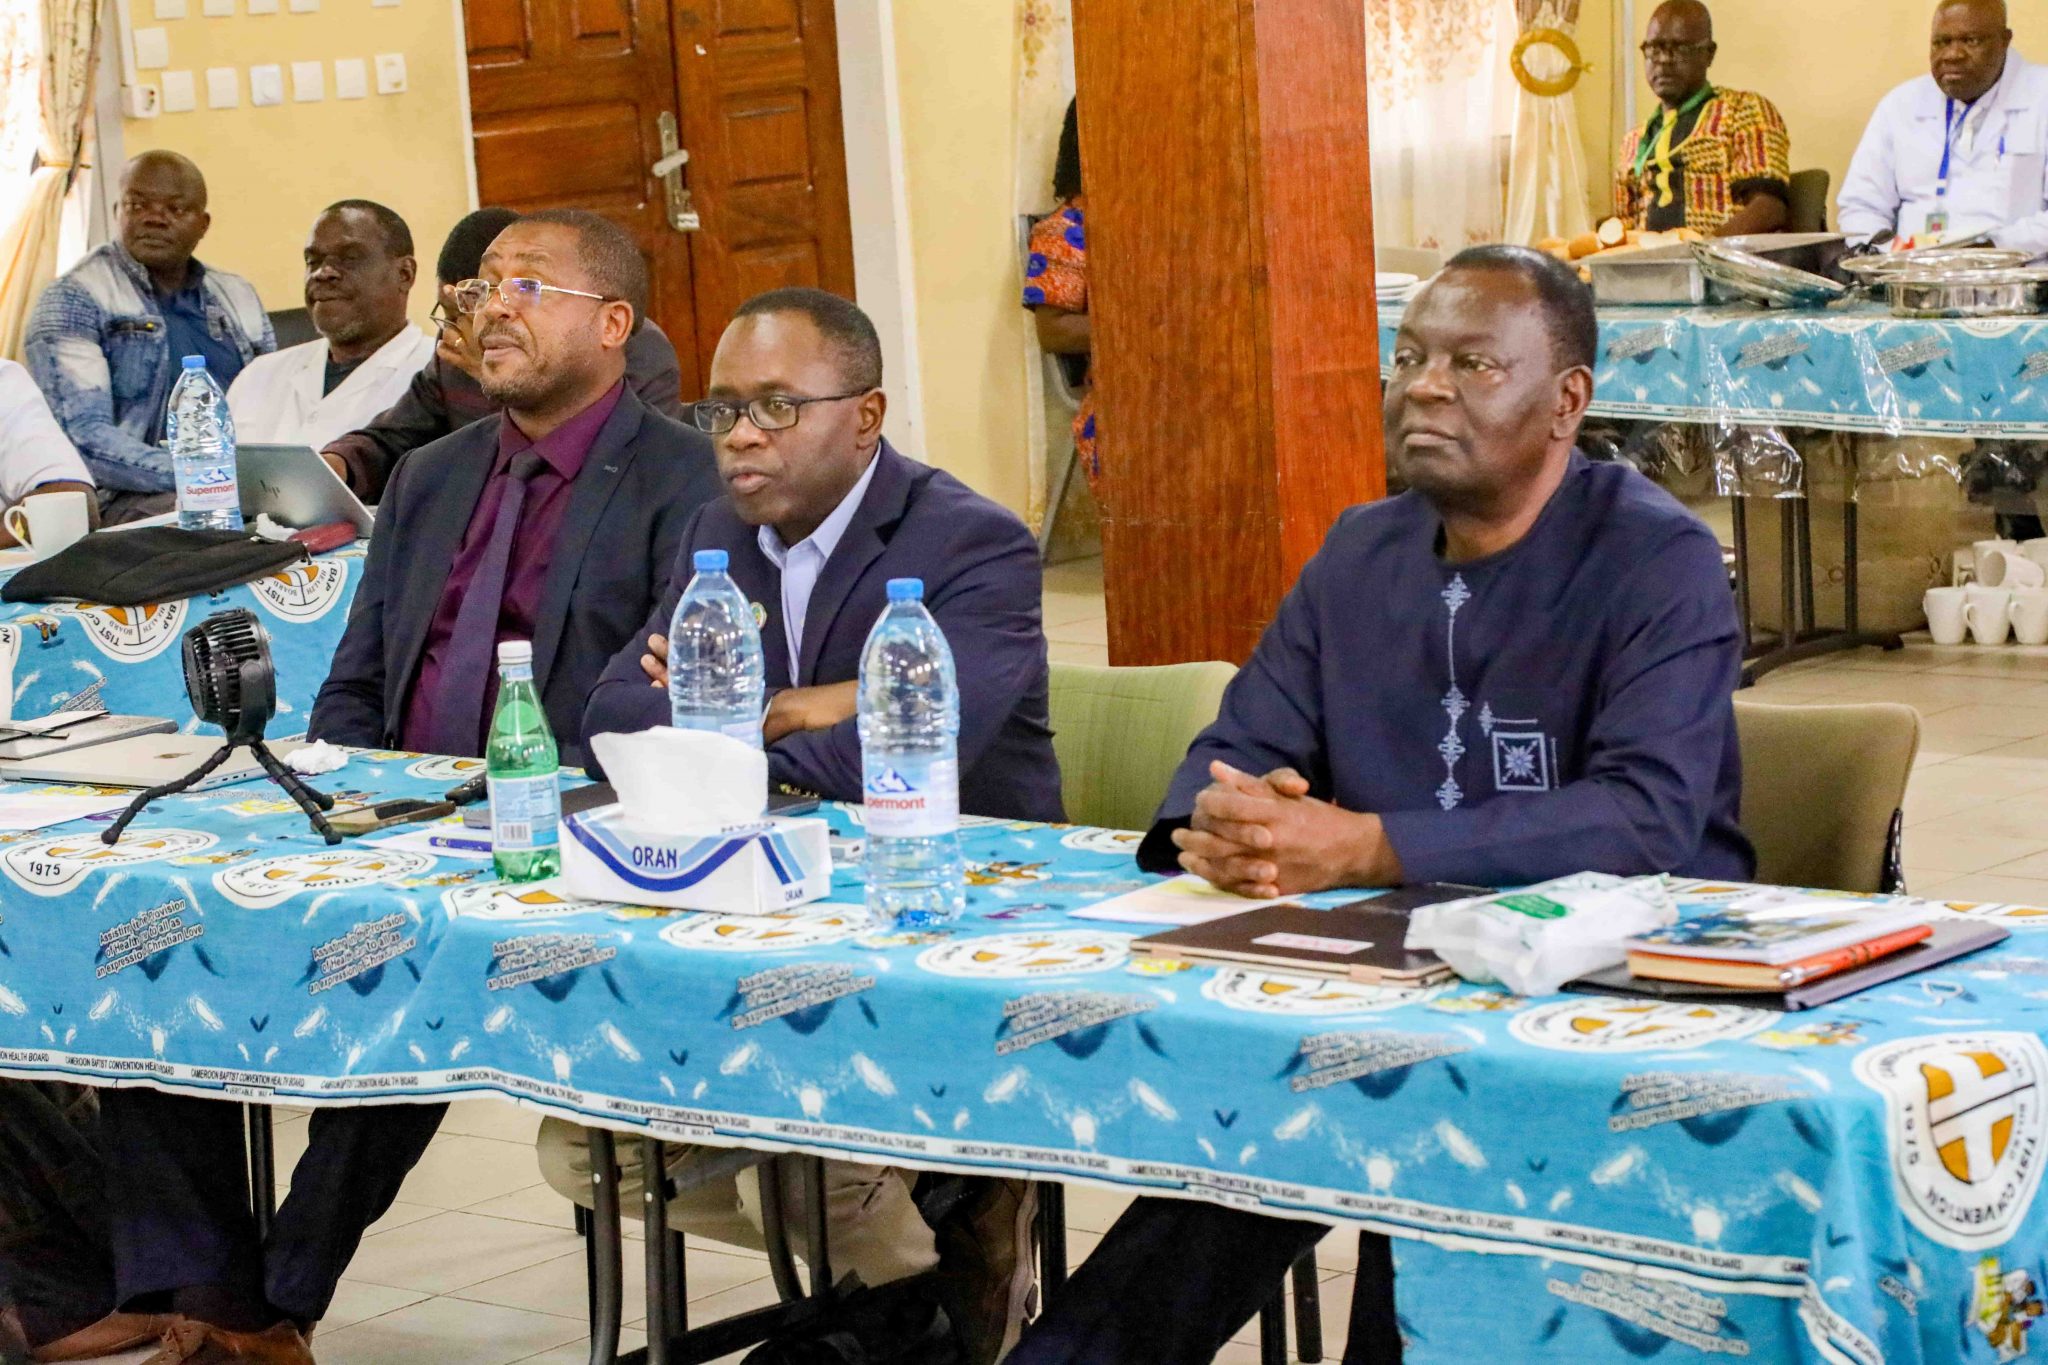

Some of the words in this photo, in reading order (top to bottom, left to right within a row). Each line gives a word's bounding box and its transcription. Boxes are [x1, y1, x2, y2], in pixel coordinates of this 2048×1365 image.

[99, 627, 119, 646] TIST
[633, 846, 677, 868] ORAN
[29, 861, 61, 876] 1975
[784, 888, 804, 901] ORAN
[9, 1051, 27, 1061] HEALTH
[28, 1052, 50, 1063] BOARD
[65, 1055, 91, 1067] CAMEROON
[108, 1060, 144, 1071] CONVENTION
[191, 1067, 219, 1080] CAMEROON
[220, 1070, 239, 1081] BAPTIST
[446, 1070, 490, 1083] CAMEROON
